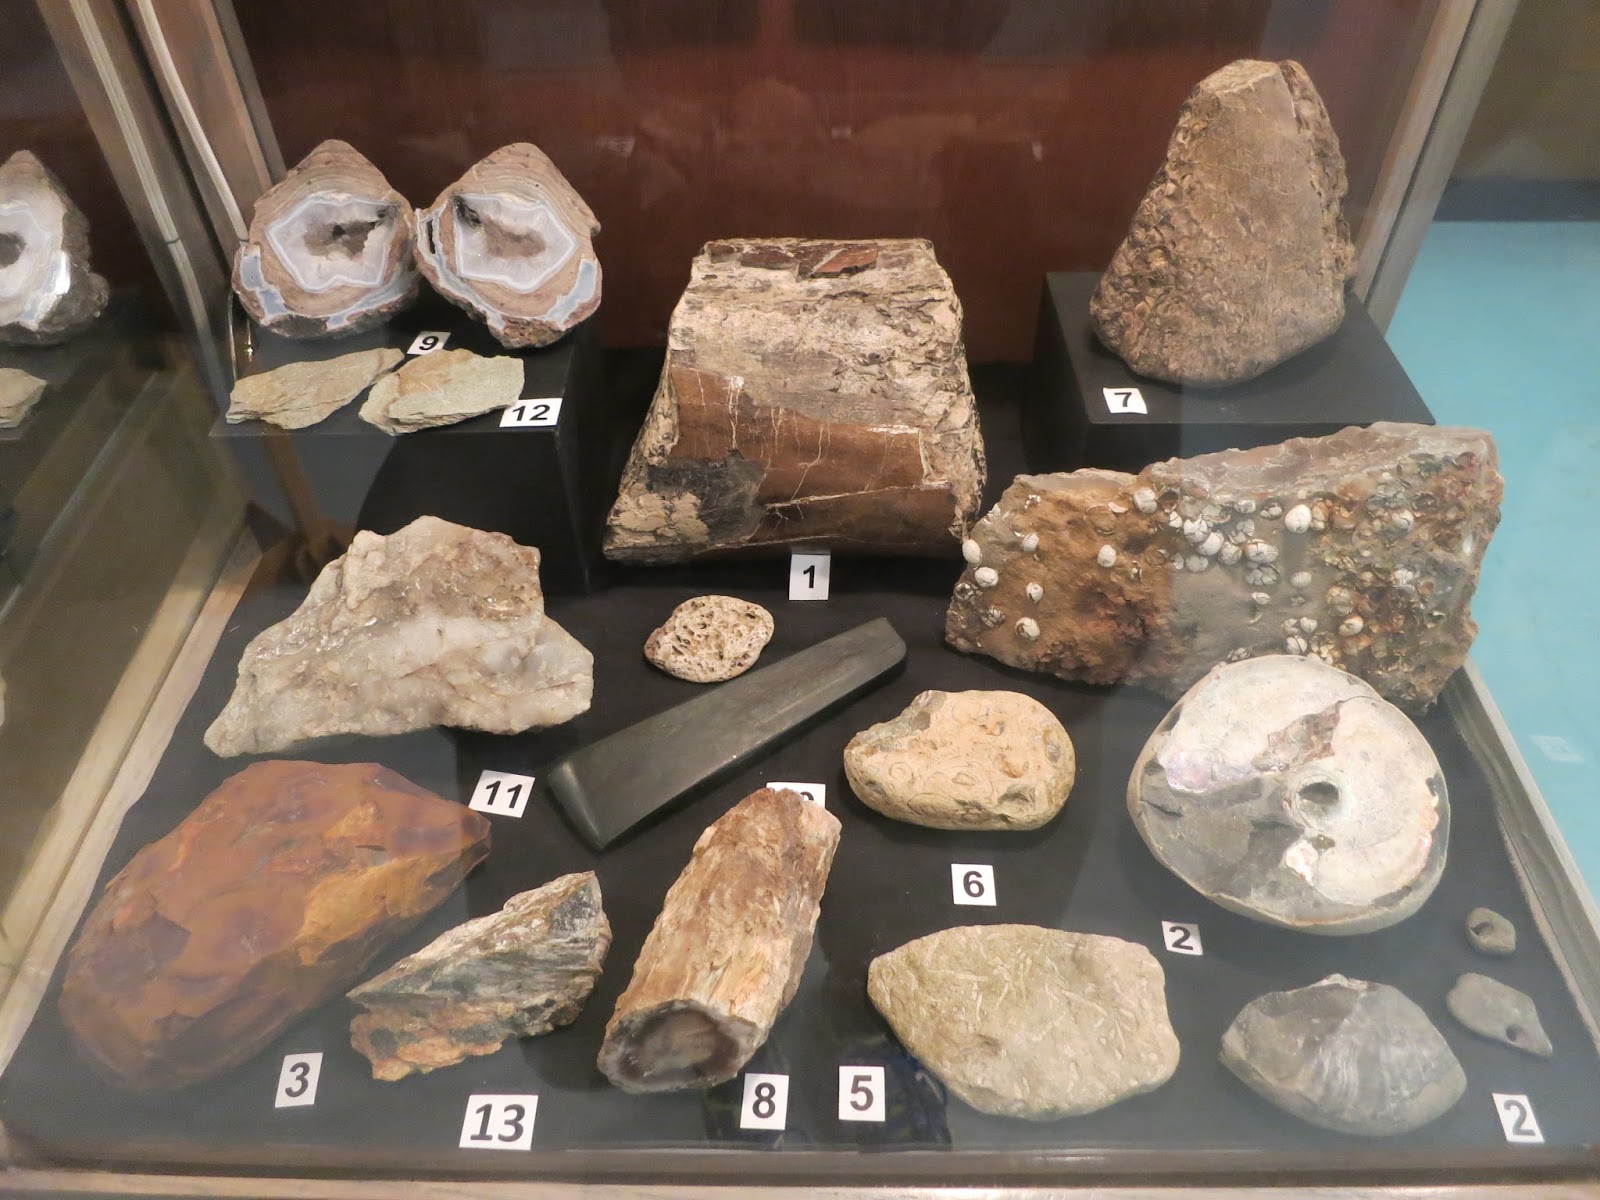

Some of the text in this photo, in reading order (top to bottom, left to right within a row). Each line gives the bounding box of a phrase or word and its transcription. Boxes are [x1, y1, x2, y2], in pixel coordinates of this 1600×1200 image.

[419, 336, 439, 350] 9
[512, 404, 550, 422] 12
[1114, 392, 1132, 407] 7
[803, 565, 815, 588] 1
[484, 780, 523, 809] 11
[963, 871, 985, 898] 6
[1169, 926, 1194, 950] 2
[285, 1062, 310, 1097] 3
[850, 1075, 873, 1111] 5
[752, 1083, 776, 1119] 8
[470, 1103, 526, 1142] 13
[1503, 1100, 1535, 1136] 2
